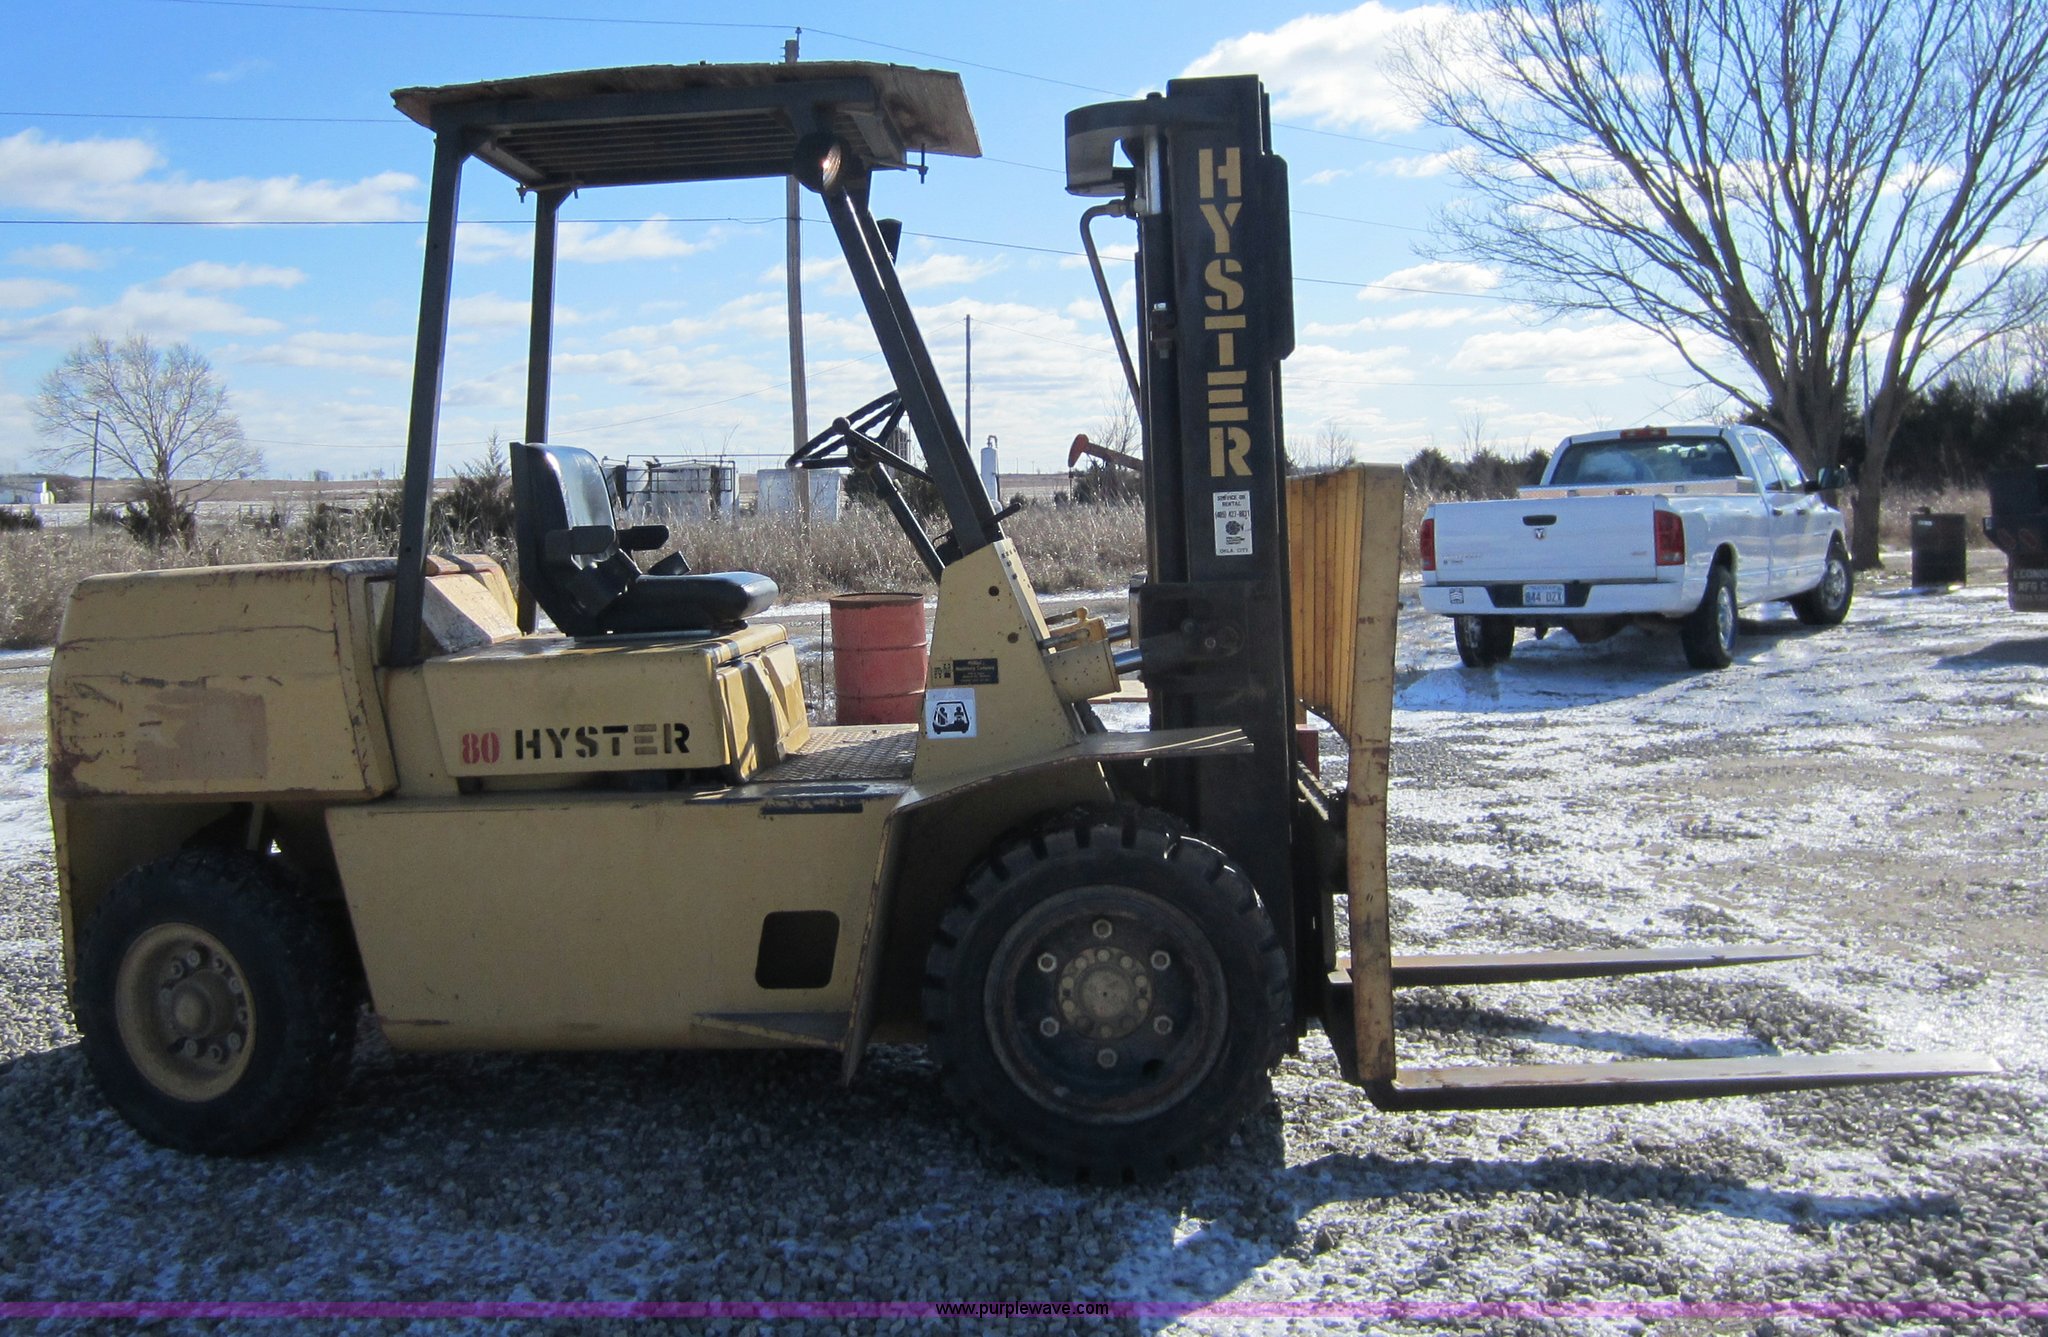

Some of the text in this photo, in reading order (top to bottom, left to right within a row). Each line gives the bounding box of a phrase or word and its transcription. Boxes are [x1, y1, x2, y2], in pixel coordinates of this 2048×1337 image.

[1199, 147, 1252, 477] HYSTER
[462, 723, 690, 764] 80 HYSTER
